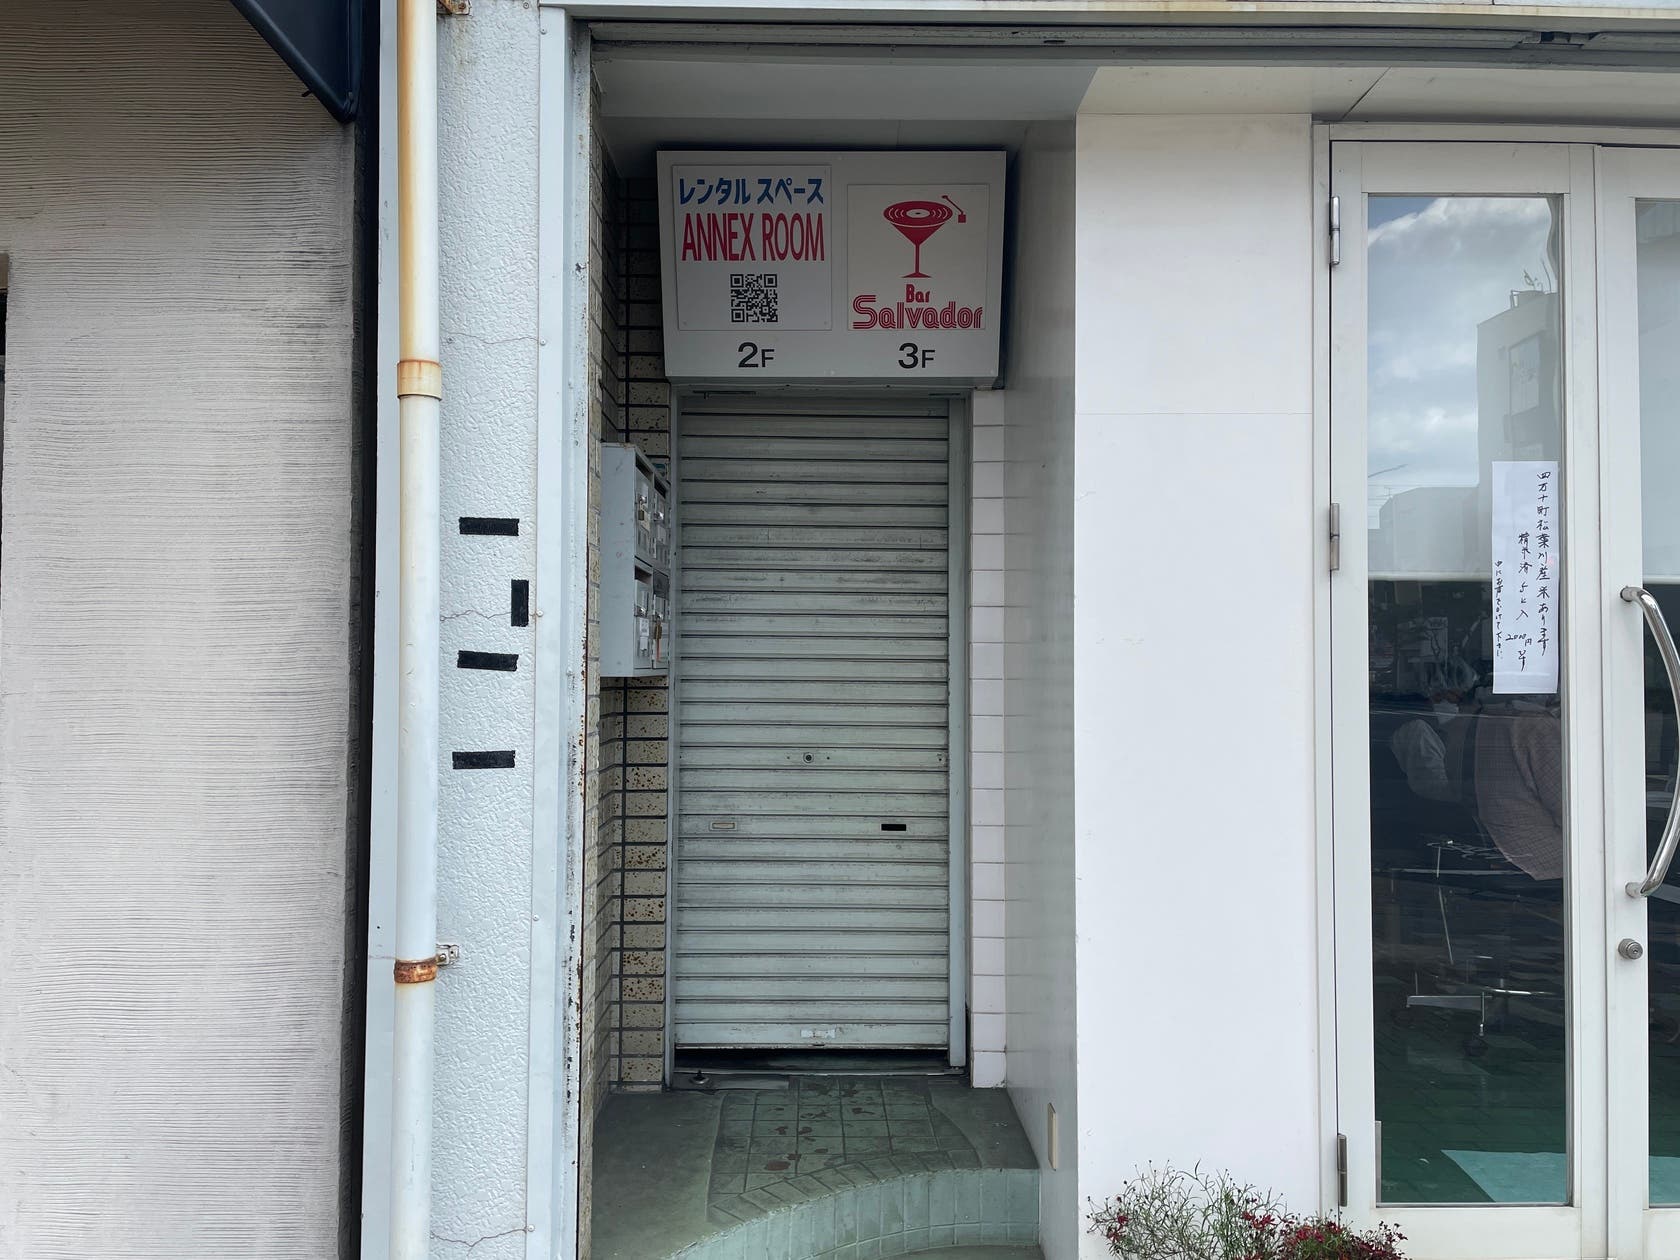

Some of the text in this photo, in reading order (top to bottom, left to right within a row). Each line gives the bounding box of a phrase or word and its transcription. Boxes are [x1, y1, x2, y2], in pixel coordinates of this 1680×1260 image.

[680, 177, 824, 205] レンタル スペース
[681, 212, 825, 262] ANNEX ROOM
[905, 283, 931, 304] Bar
[852, 294, 984, 330] Salvador
[737, 342, 775, 369] 2F
[898, 342, 936, 369] 3F
